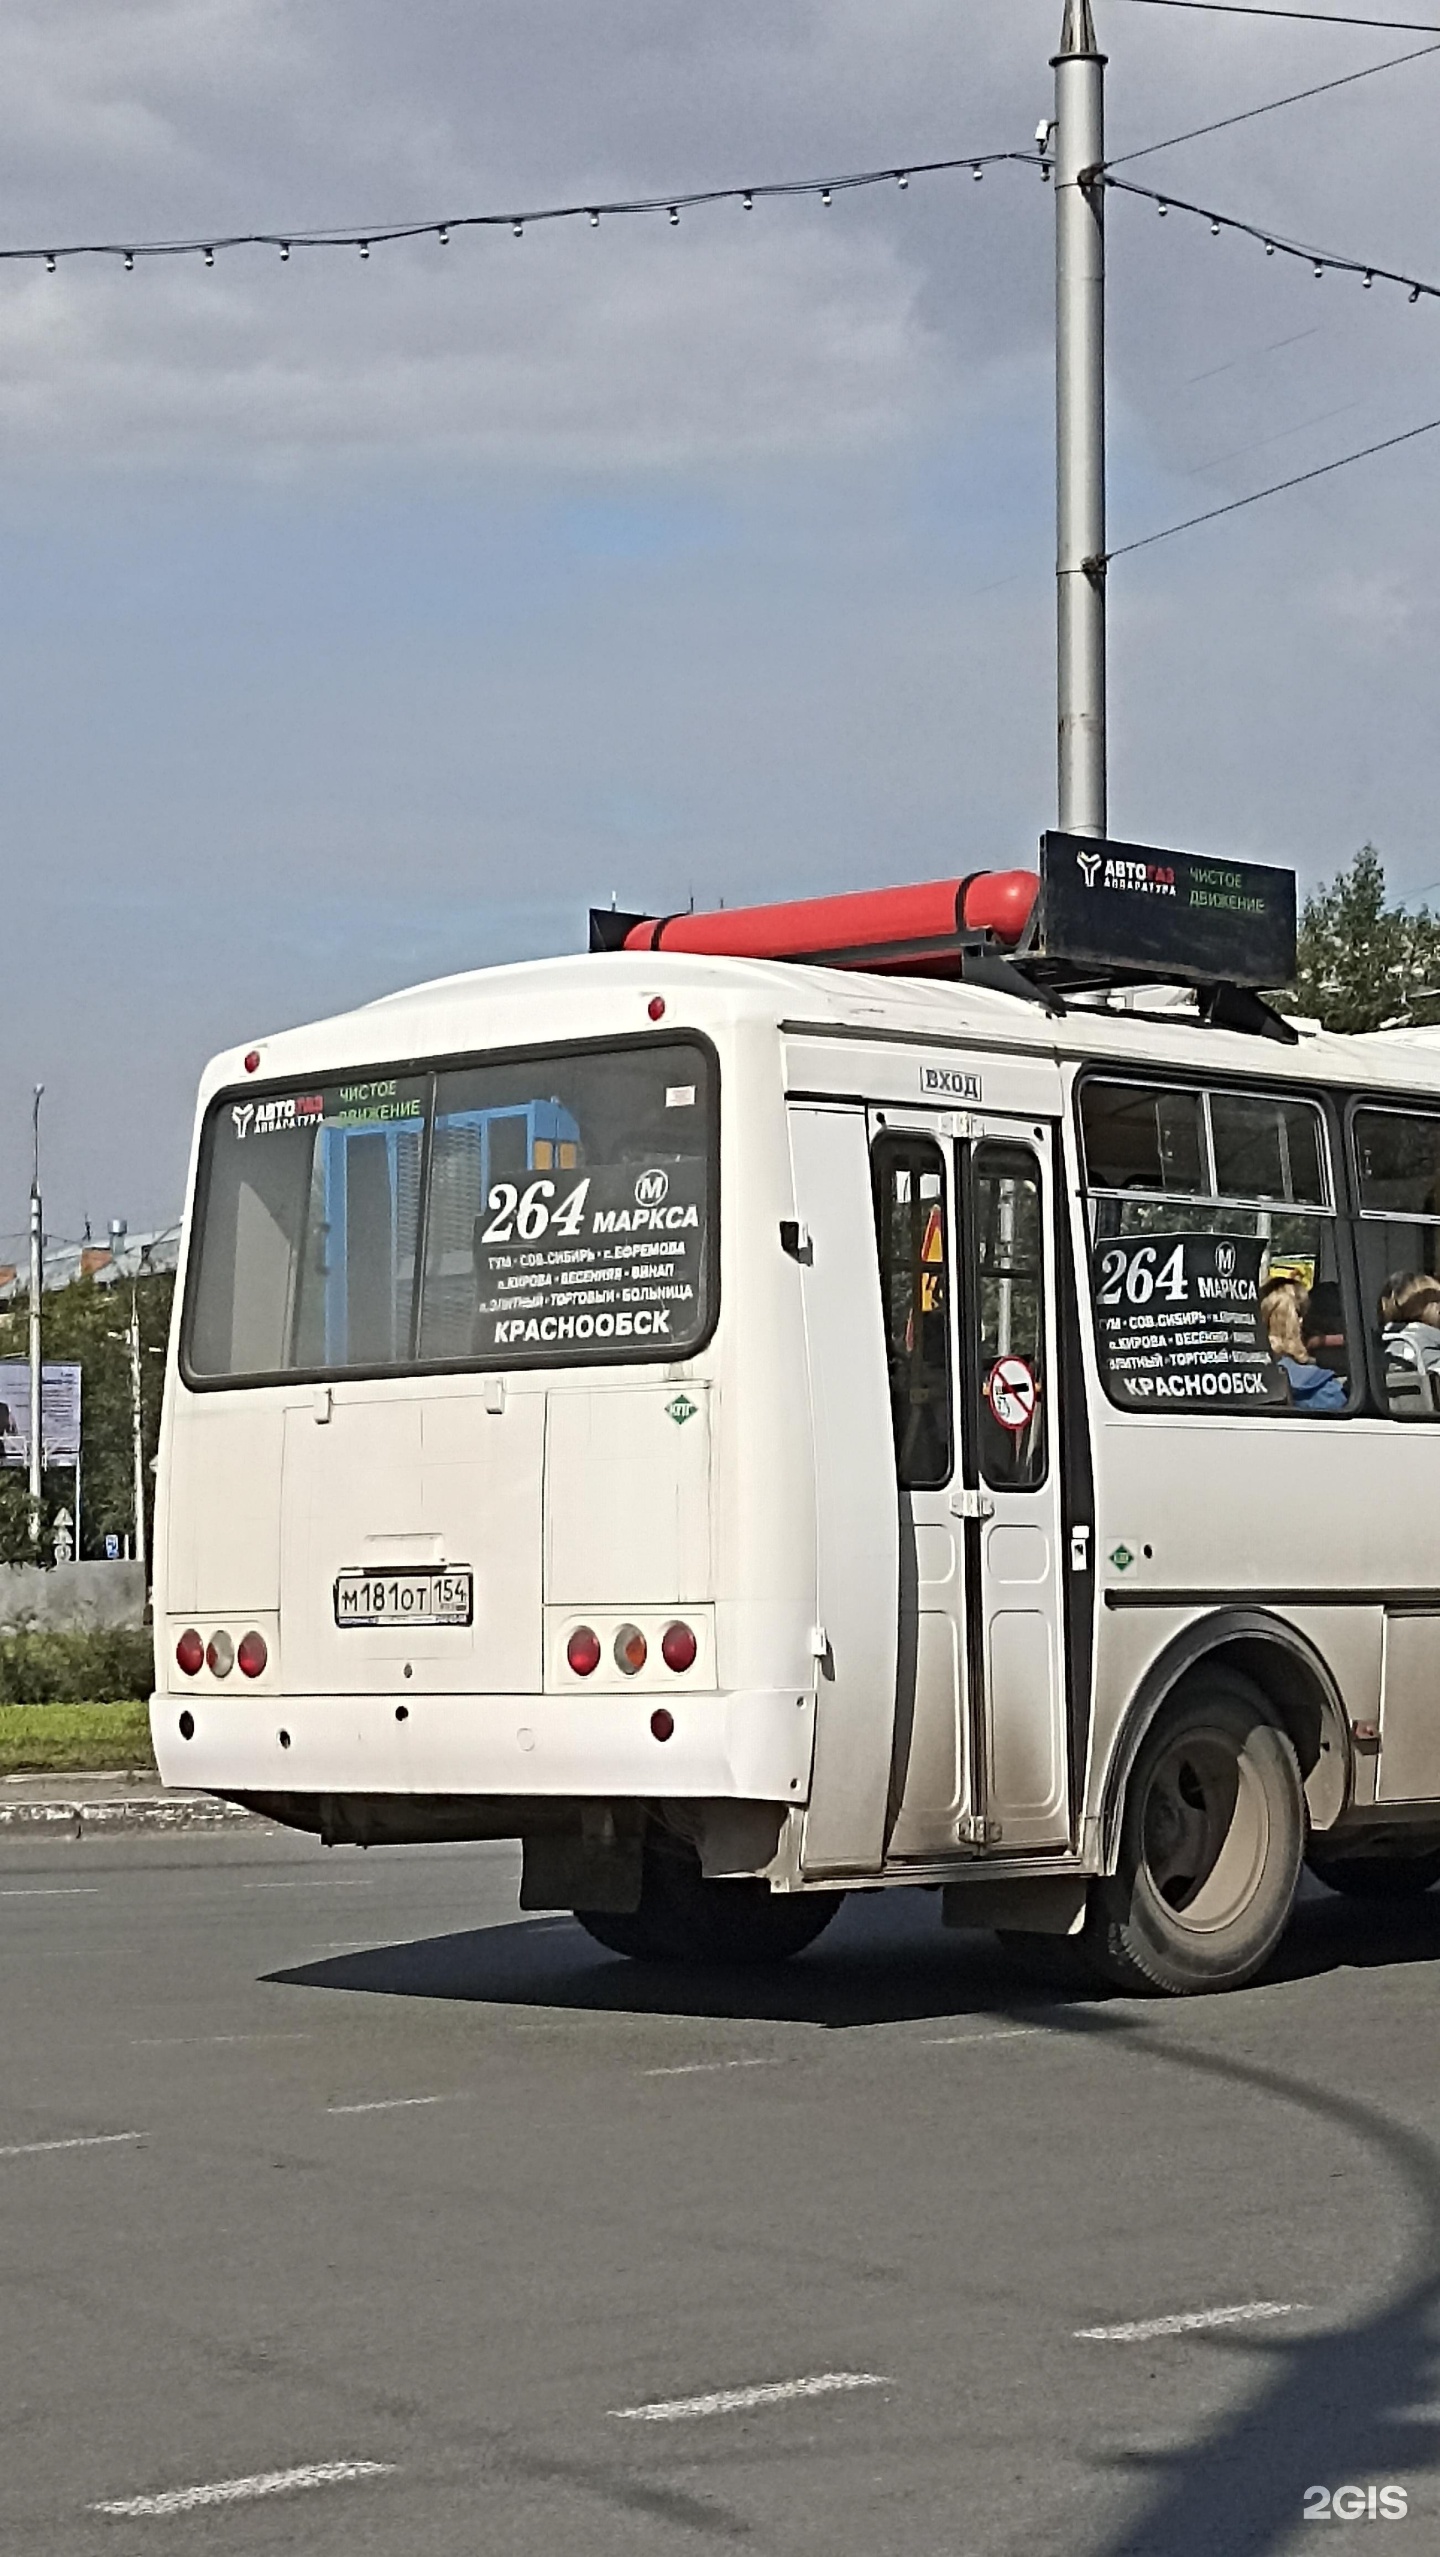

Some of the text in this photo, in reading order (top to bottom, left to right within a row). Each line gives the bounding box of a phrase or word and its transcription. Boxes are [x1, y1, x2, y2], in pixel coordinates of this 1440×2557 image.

[1104, 860, 1175, 884] АВТОГАЗ
[1189, 866, 1242, 888] ЧИСТОЕ
[1189, 889, 1265, 913] ДВИЖЕНИЕ
[340, 1080, 397, 1103] ЧИСТОЕ
[926, 1069, 978, 1098] ВХОД
[481, 1178, 591, 1243] 264
[592, 1204, 699, 1233] МАРКСА
[1097, 1244, 1188, 1304] 264
[622, 1284, 693, 1302] БОЛЬНИЦА
[1197, 1277, 1258, 1300] МАРКСА
[494, 1309, 671, 1343] КРАСНООБСК
[1123, 1372, 1268, 1397] КРАСНООБСК
[434, 1579, 467, 1603] 154
